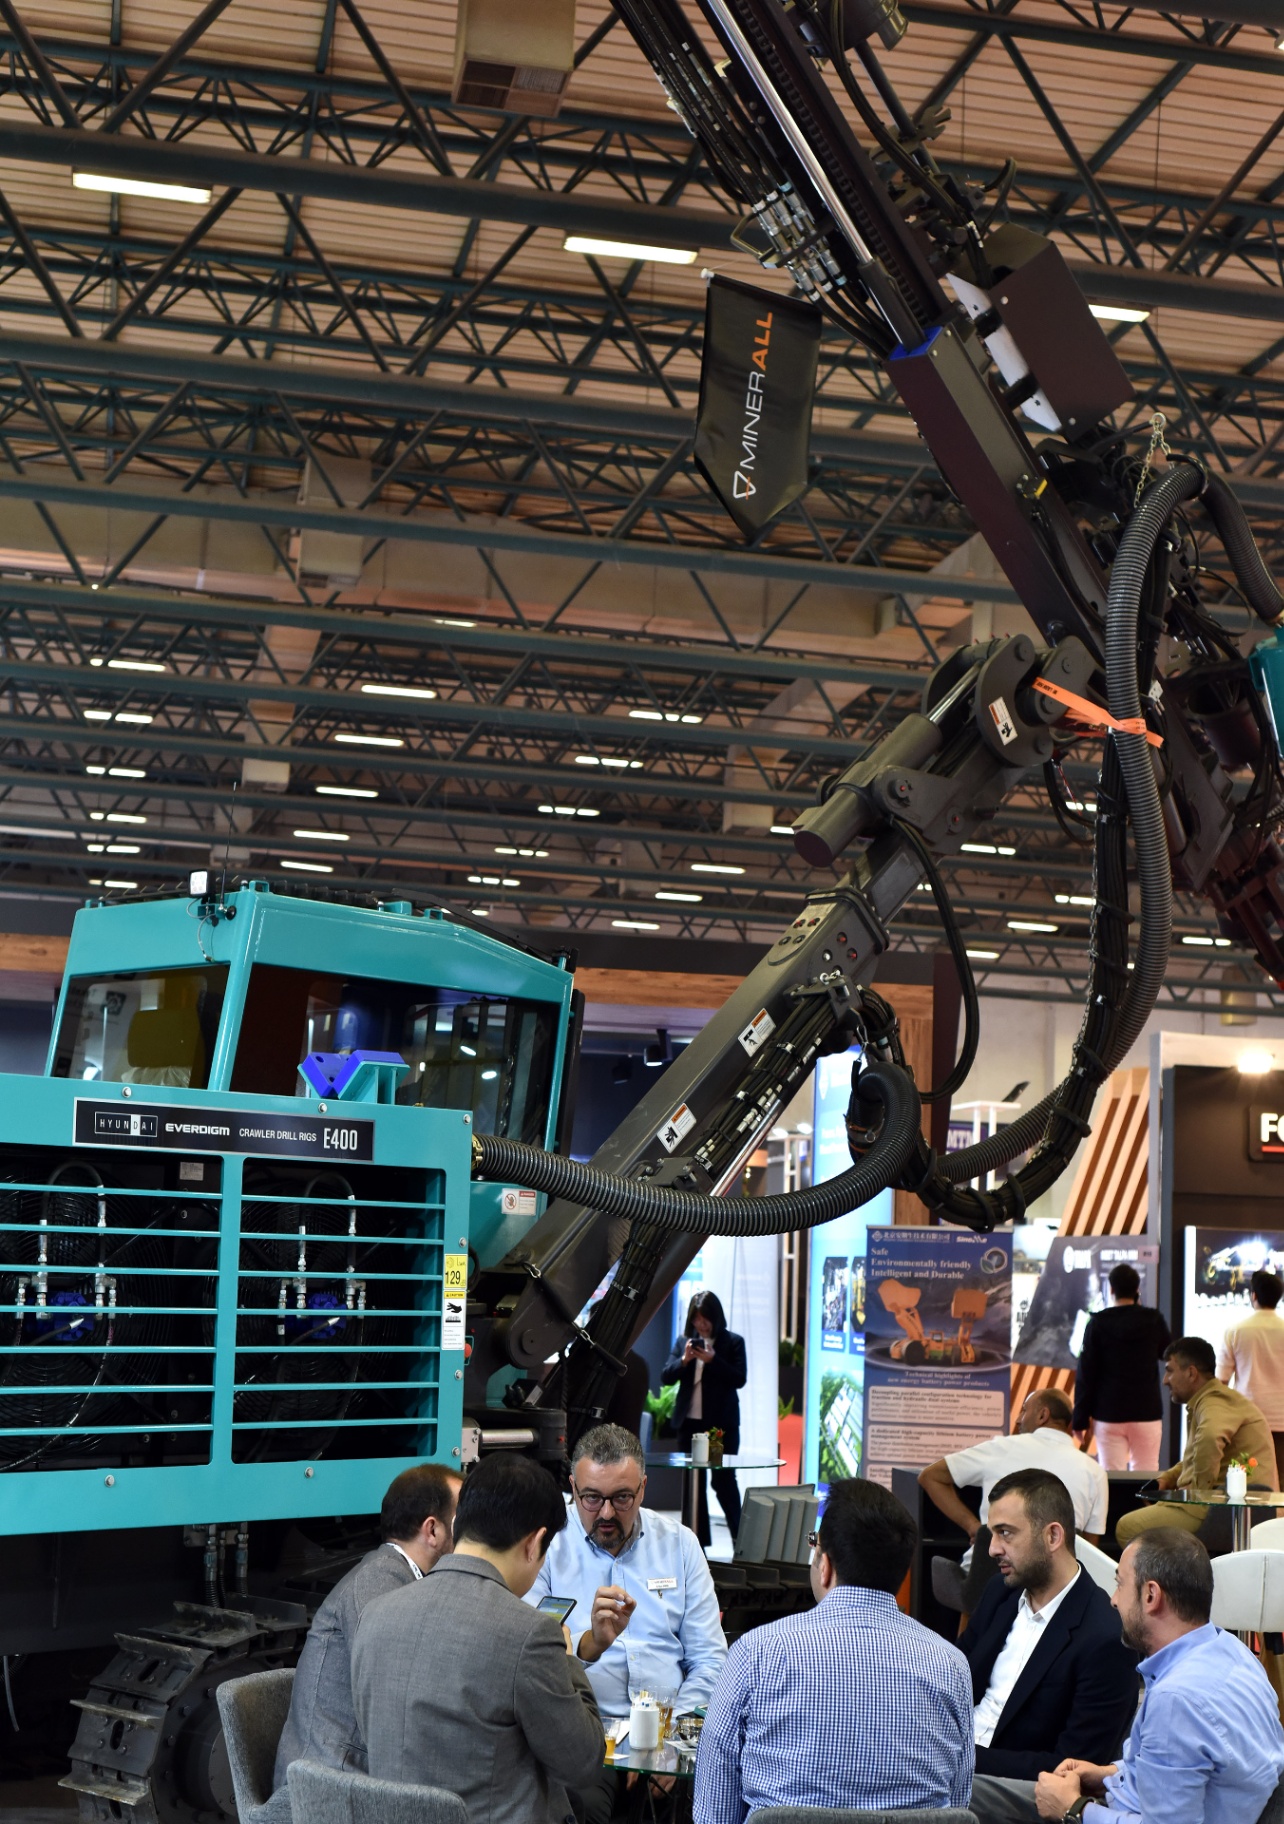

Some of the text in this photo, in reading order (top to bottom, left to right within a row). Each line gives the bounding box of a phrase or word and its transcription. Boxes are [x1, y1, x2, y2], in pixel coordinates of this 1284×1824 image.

[740, 312, 773, 470] MINERALL
[99, 1118, 358, 1151] HYUNDAI EVERDIGM CRAWLER DRILL RIGS E400
[871, 1247, 889, 1256] Safe
[871, 1258, 972, 1271] Environmentally friendly
[445, 1270, 461, 1285] 129
[871, 1269, 965, 1280] Intelligent and Durable
